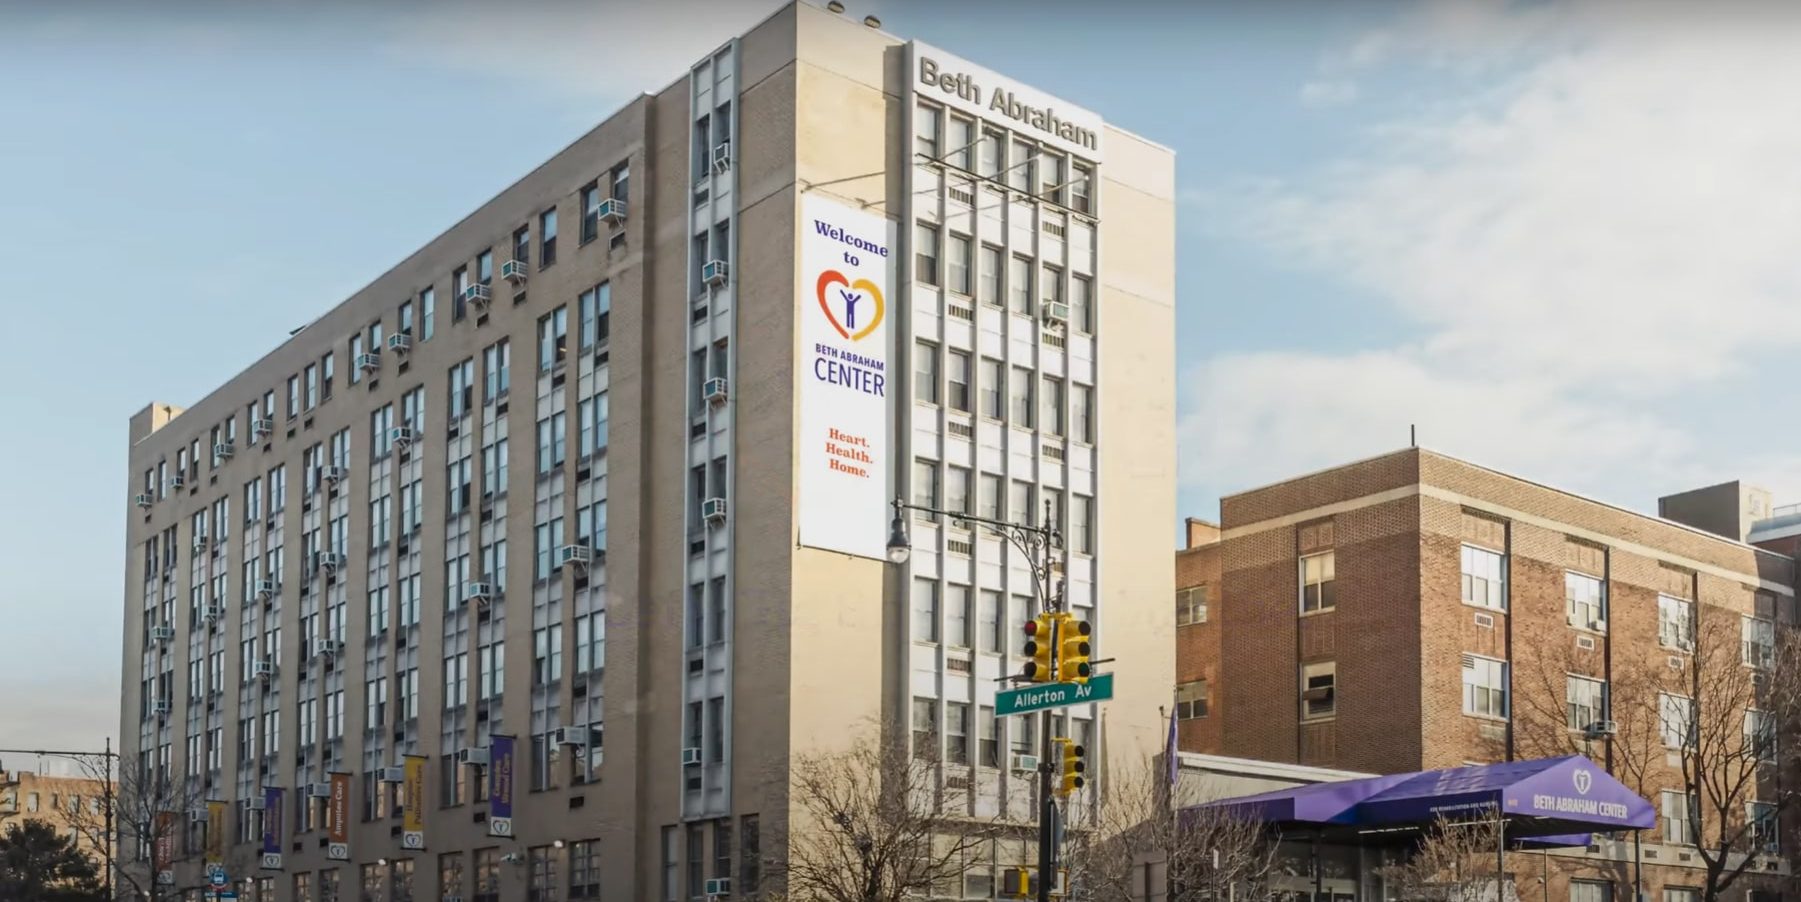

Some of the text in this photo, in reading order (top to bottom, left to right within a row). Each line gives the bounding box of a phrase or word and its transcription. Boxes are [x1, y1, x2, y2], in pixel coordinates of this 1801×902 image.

[920, 56, 1098, 151] Beth Abraham
[814, 219, 889, 257] Welcome
[843, 251, 860, 267] to
[815, 343, 884, 371] BETH ABRAHAM
[814, 357, 885, 397] CENTER
[829, 427, 870, 448] Heart.
[825, 442, 873, 464] Health.
[829, 458, 870, 478] Home.
[1014, 685, 1092, 708] Allerton Av
[334, 781, 343, 801] Care
[1533, 794, 1628, 819] BETH ABRAHAM CENTER
